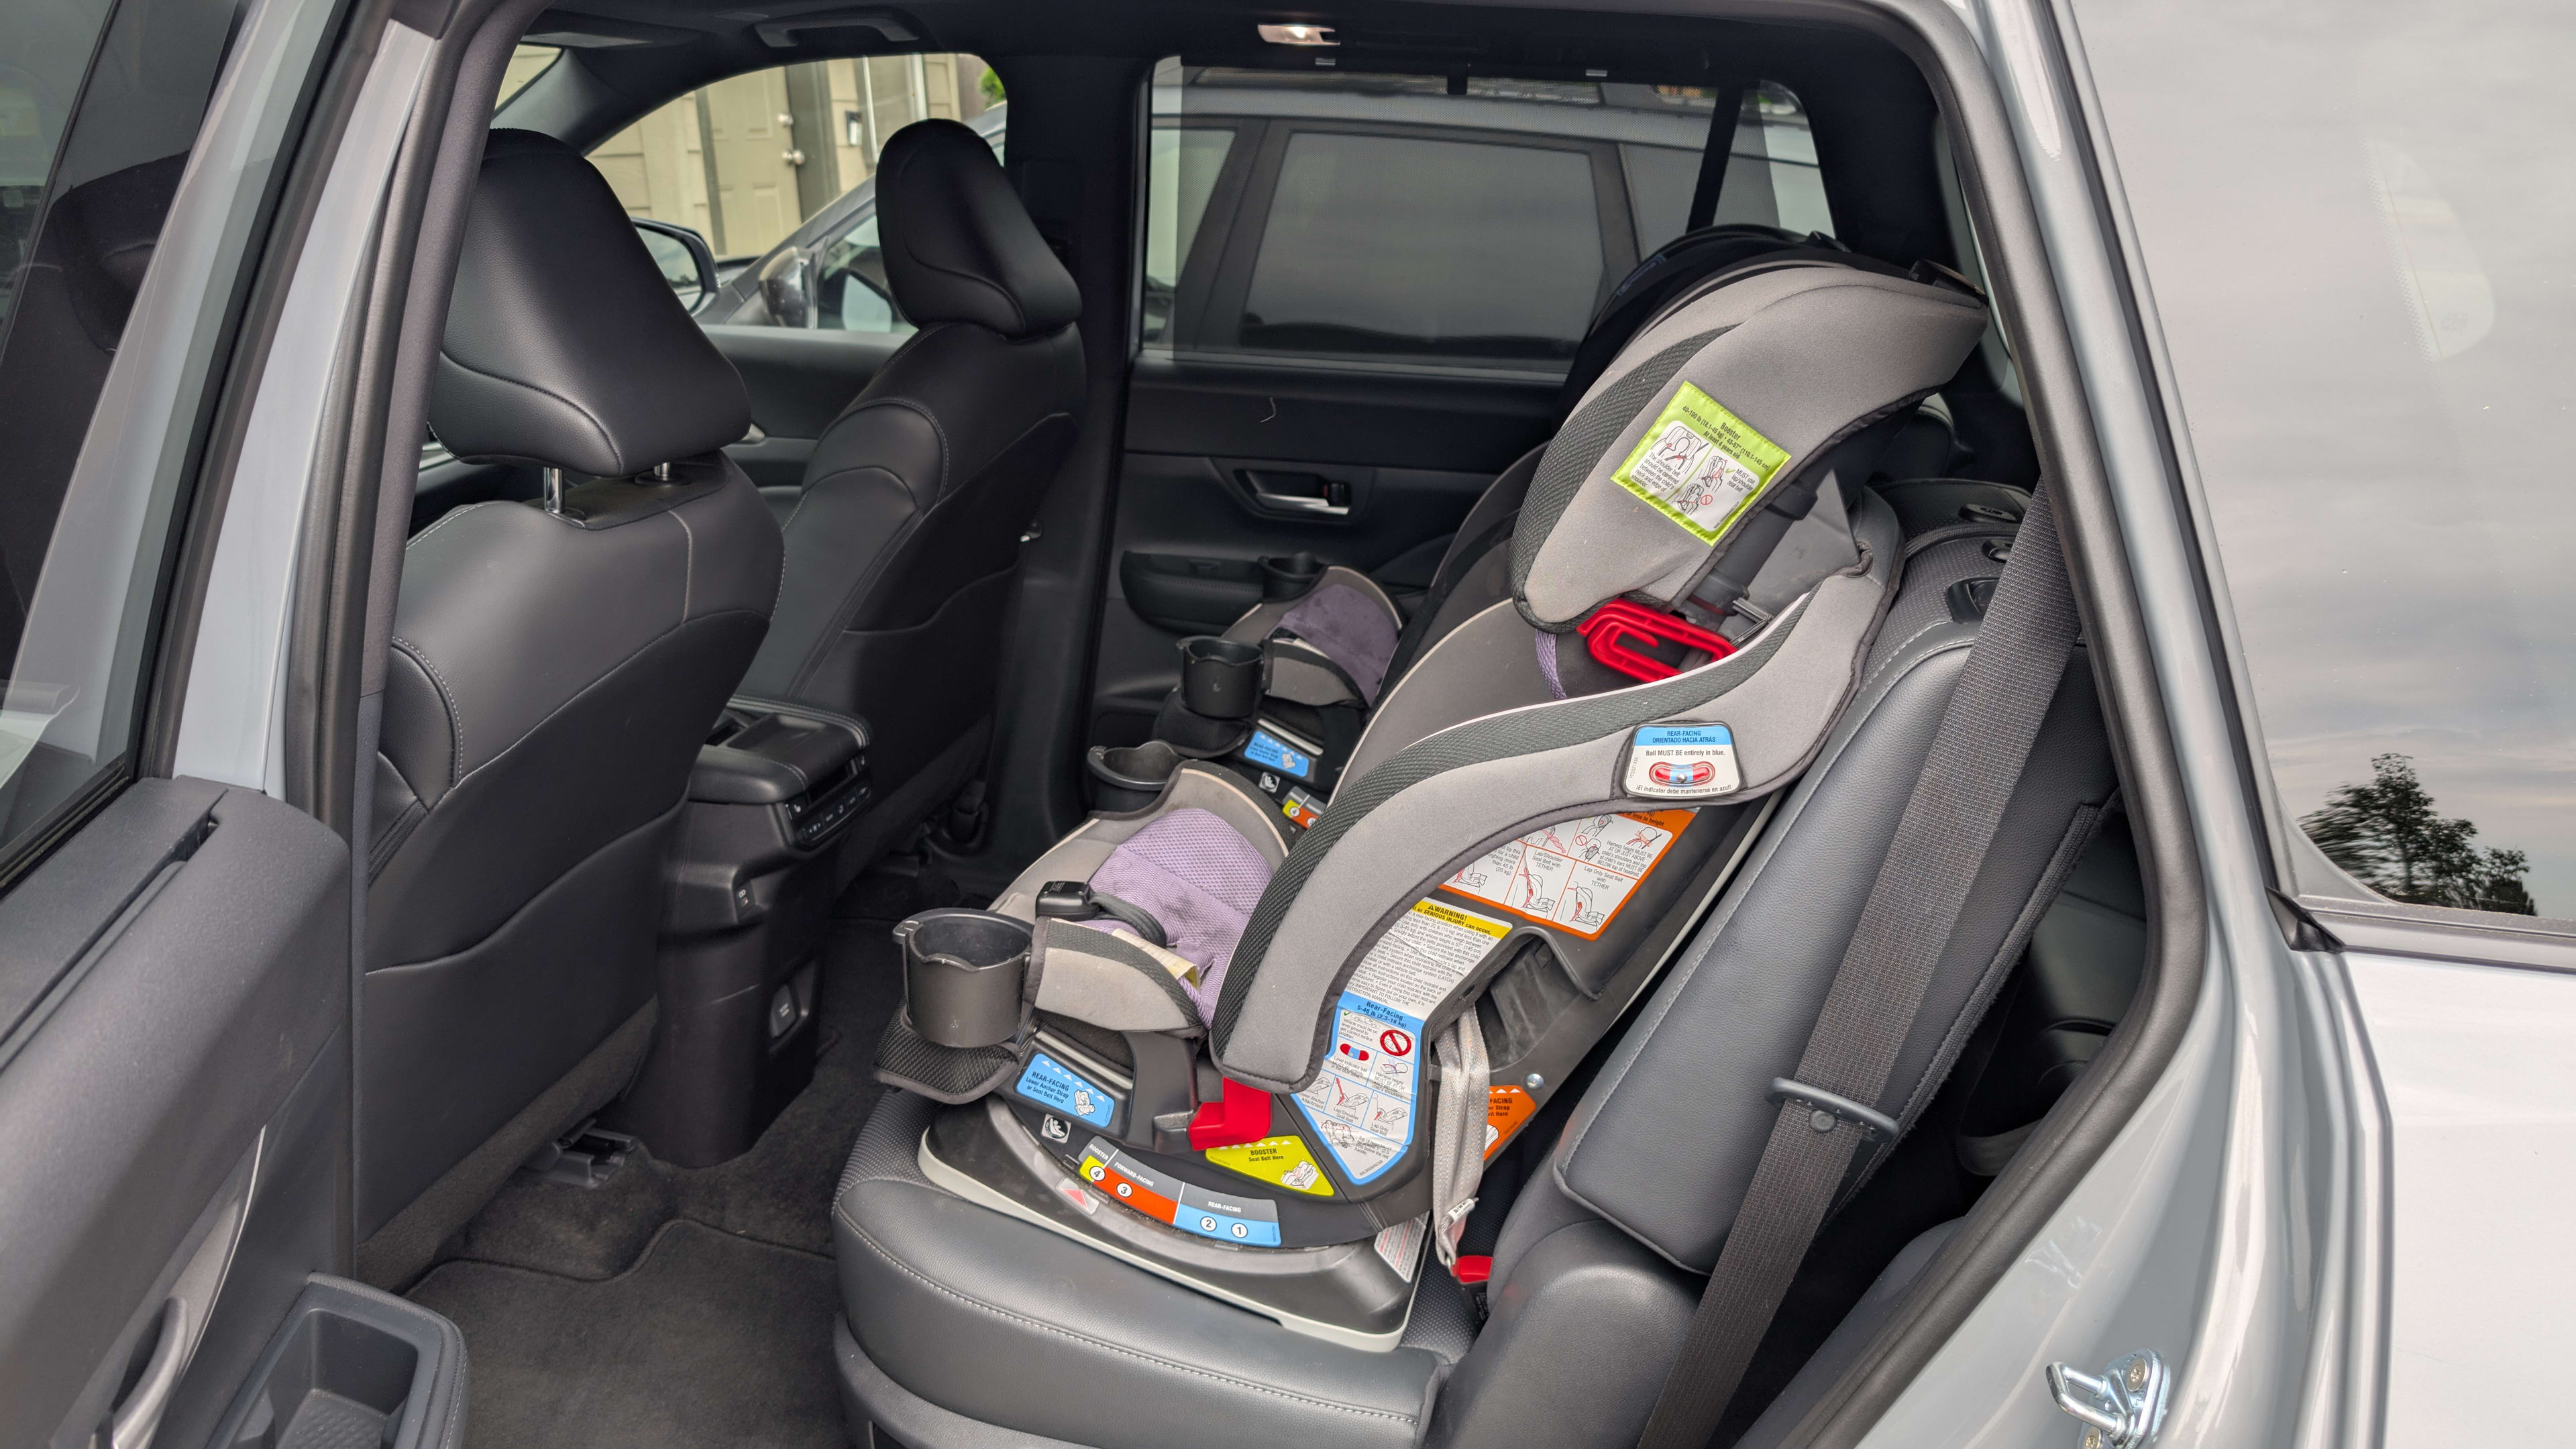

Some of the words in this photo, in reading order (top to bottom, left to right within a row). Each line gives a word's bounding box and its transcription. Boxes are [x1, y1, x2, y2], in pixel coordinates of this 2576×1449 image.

[1680, 405, 1698, 419] 40-100
[1719, 421, 1742, 441] Booster
[1707, 433, 1720, 445] least
[1720, 443, 1733, 455] years
[1731, 451, 1741, 460] old
[1644, 458, 1658, 470] should
[1661, 470, 1679, 485] centered
[1648, 451, 1658, 462] The
[1655, 458, 1674, 472] shoulder
[1671, 469, 1680, 478] belt
[1634, 468, 1646, 478] neck
[1644, 474, 1653, 483] and
[1650, 480, 1662, 490] edge
[1639, 462, 1657, 478] between
[1654, 474, 1663, 482] the
[1735, 468, 1750, 480] MUST
[1747, 476, 1756, 485] use
[1726, 479, 1736, 488] seat
[1734, 484, 1743, 493] belt
[1606, 839, 1623, 849] Harness
[1621, 845, 1635, 854] height
[1633, 848, 1647, 857] MUST
[1531, 854, 1543, 863] Seat
[1551, 861, 1562, 869] with
[1533, 849, 1563, 865] Lap/Shoulder
[1597, 859, 1612, 868] BELOW
[1613, 853, 1633, 864] shoulders
[1631, 853, 1646, 862] ABOVE
[1535, 861, 1554, 872] TETHER
[1625, 863, 1638, 871] MUST
[1583, 865, 1593, 873] Lap
[1592, 868, 1605, 877] Only
[1603, 871, 1614, 880] Seat
[1613, 875, 1623, 883] Belt
[1596, 875, 1607, 883] with
[1590, 879, 1609, 890] TETHER
[1423, 908, 1446, 920] SERIOUS
[1446, 916, 1465, 926] INJURY
[1432, 906, 1467, 921] WARNING!
[1356, 1004, 1371, 1016] 5-40
[1398, 1019, 1407, 1028] kg)
[1366, 1001, 1404, 1021] Rear-Facing
[1342, 1018, 1357, 1026] Vehicle
[1346, 1028, 1361, 1037] correct
[1360, 1034, 1373, 1042] recline
[1350, 1025, 1364, 1034] ground
[1031, 1070, 1070, 1091] REAR-FACING
[1375, 1071, 1392, 1080] Harness
[1025, 1076, 1040, 1086] Lower
[1039, 1082, 1057, 1093] Anchor
[1055, 1089, 1069, 1099] Strap
[1032, 1086, 1044, 1095] Seat
[1042, 1091, 1053, 1099] Belt
[1053, 1095, 1065, 1104] Here
[1310, 1095, 1326, 1105] Anchor
[1332, 1106, 1360, 1120] Lap/Shoulder
[1335, 1112, 1346, 1120] Seat
[1370, 1122, 1379, 1130] Lap
[1089, 1144, 1109, 1161] BOOSTER
[1250, 1148, 1278, 1156] BOOSTER
[1114, 1161, 1155, 1187] FORWARD-FACING
[1121, 1186, 1128, 1195] 3
[1208, 1201, 1242, 1213] REAR-FACING
[1205, 1219, 1212, 1228] 2
[1236, 1226, 1242, 1235] 1
